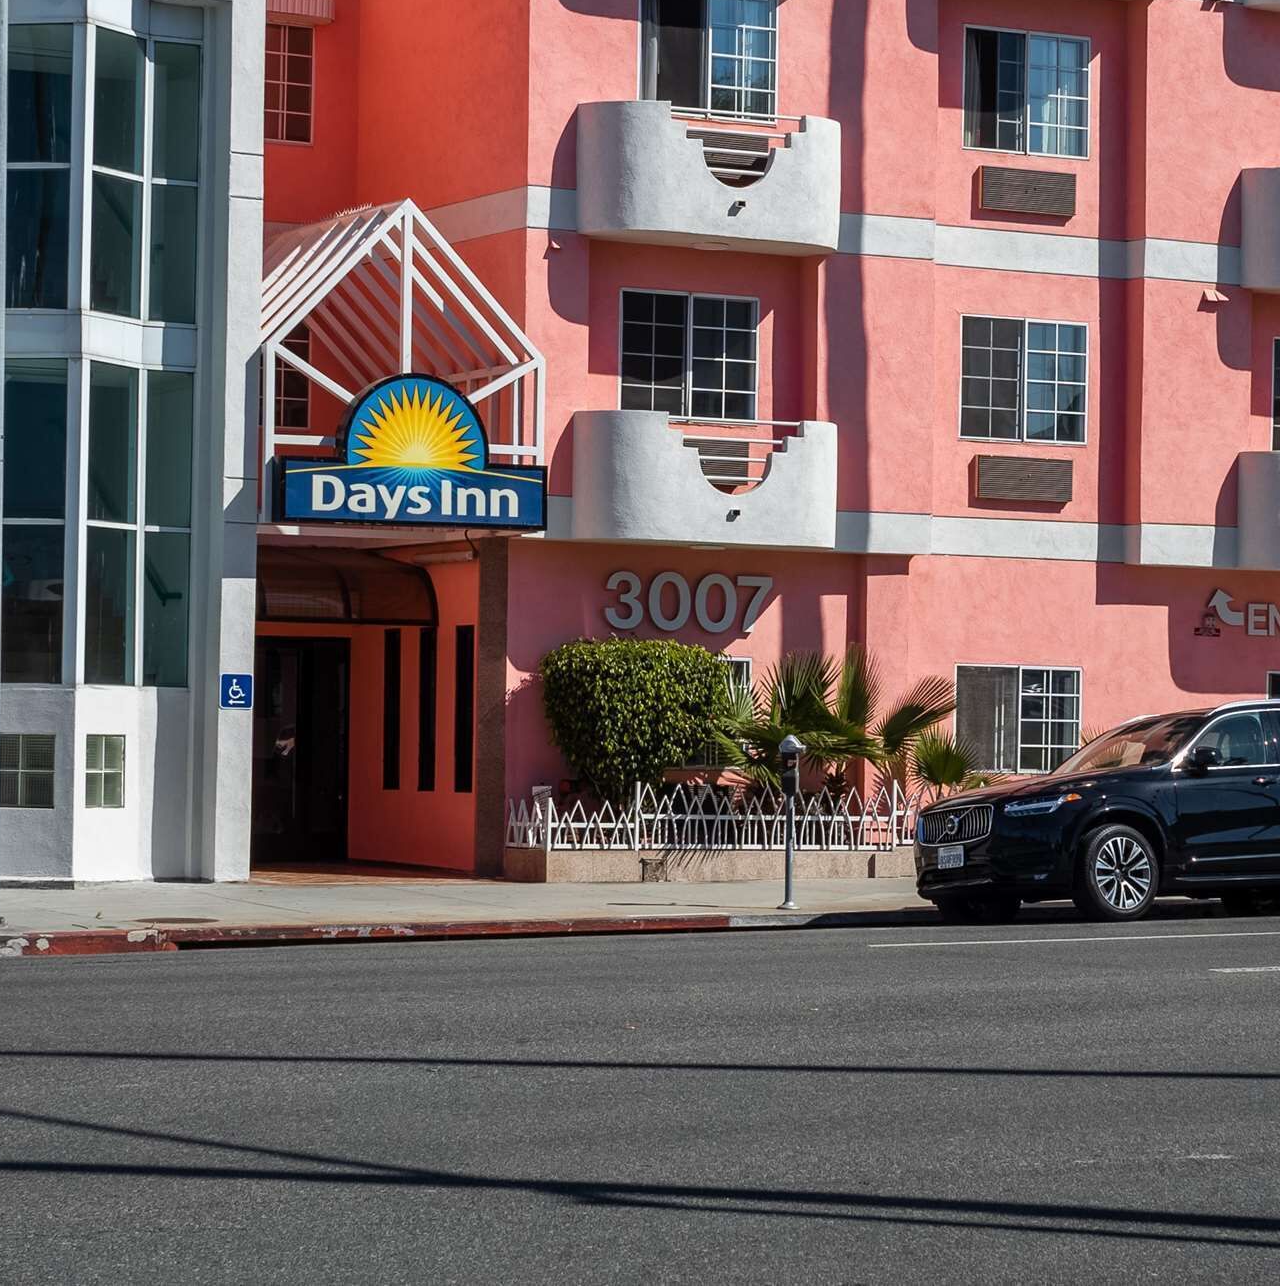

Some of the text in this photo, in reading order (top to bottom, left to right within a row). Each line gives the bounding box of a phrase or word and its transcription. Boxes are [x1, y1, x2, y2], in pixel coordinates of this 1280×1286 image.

[311, 474, 520, 520] Days Inn
[604, 570, 774, 634] 3007
